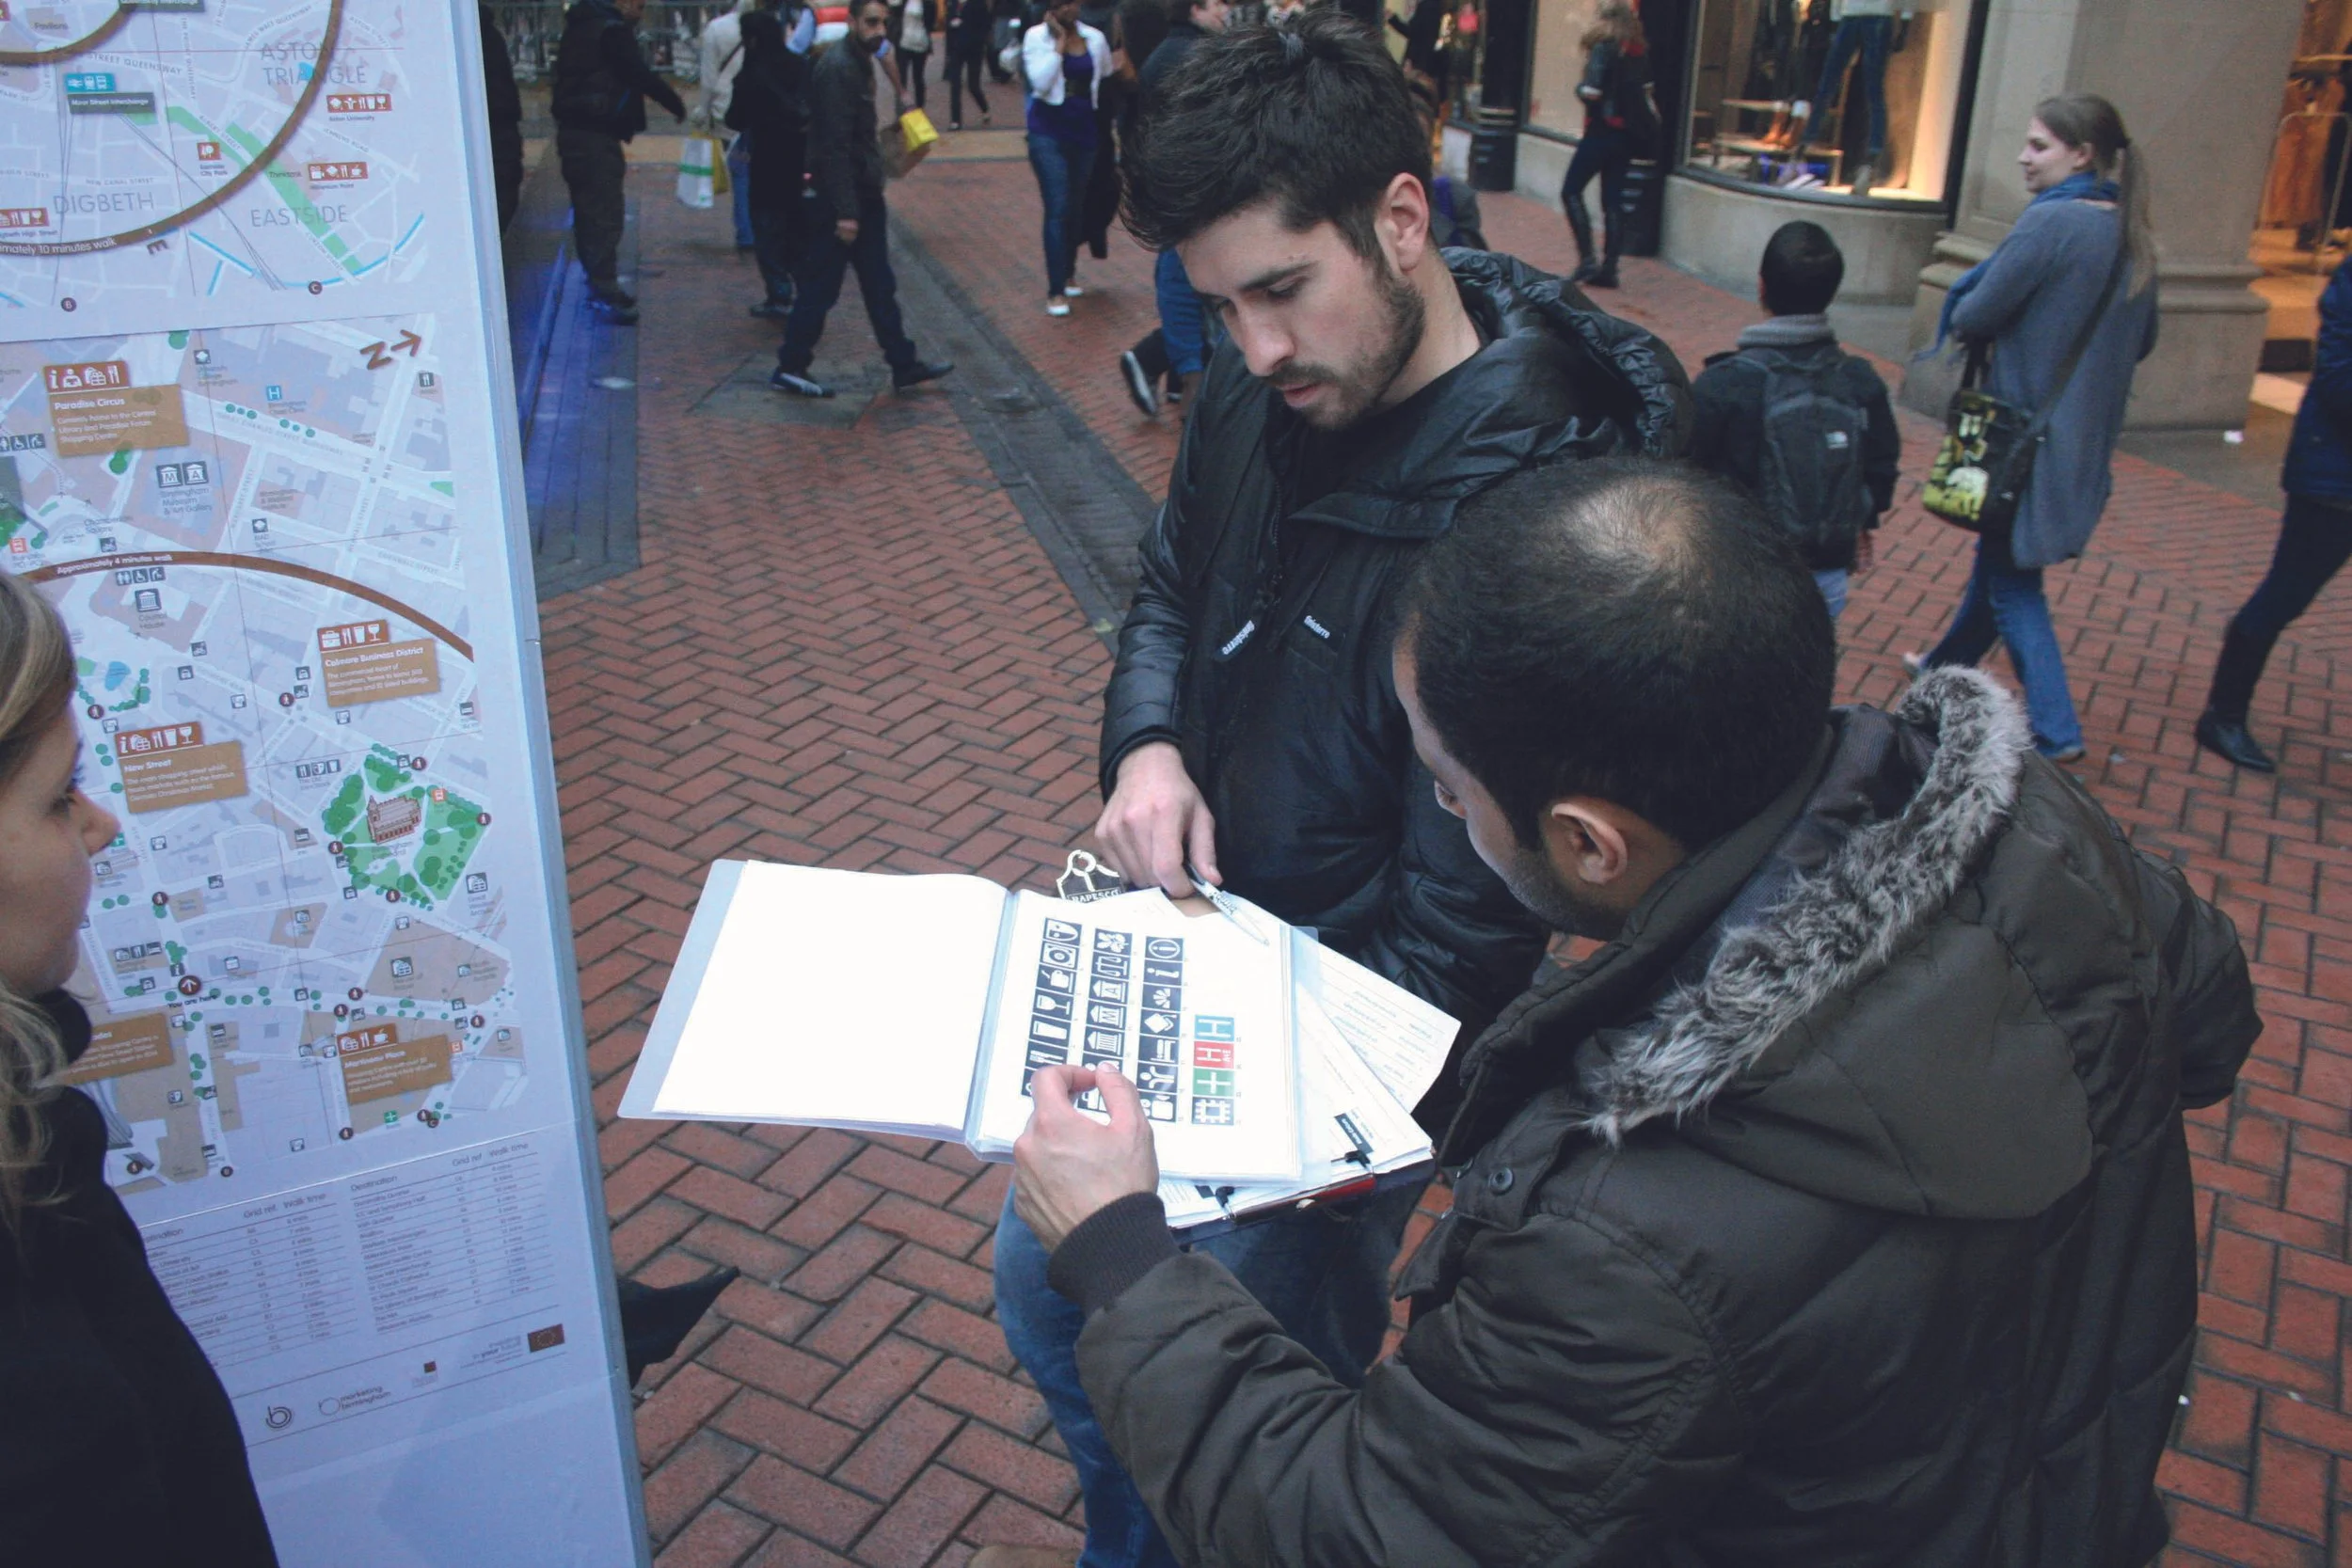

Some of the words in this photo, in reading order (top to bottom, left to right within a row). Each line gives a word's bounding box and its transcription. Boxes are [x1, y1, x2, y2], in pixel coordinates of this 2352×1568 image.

[261, 41, 325, 61] ASTO
[53, 191, 154, 215] DIGBETH
[250, 204, 349, 228] EASTSIDE
[39, 245, 50, 254] 10
[52, 243, 92, 254] minutes
[94, 237, 117, 249] walk
[55, 399, 95, 411] Paradise
[97, 398, 126, 407] Circus
[56, 559, 113, 575] Approximately
[122, 555, 152, 563] minutes
[325, 657, 358, 667] Colmore
[359, 652, 394, 663] Business
[395, 646, 424, 657] District
[146, 759, 172, 769] Street
[199, 994, 218, 1003] here
[350, 1175, 398, 1192] Destination
[452, 1157, 470, 1167] Grid
[488, 1147, 510, 1157] Walk
[510, 1142, 530, 1152] time
[244, 1209, 263, 1219] Grid
[283, 1197, 306, 1209] Walk
[307, 1193, 327, 1203] time
[340, 1385, 384, 1401] marketing
[341, 1391, 391, 1411] birmingham
